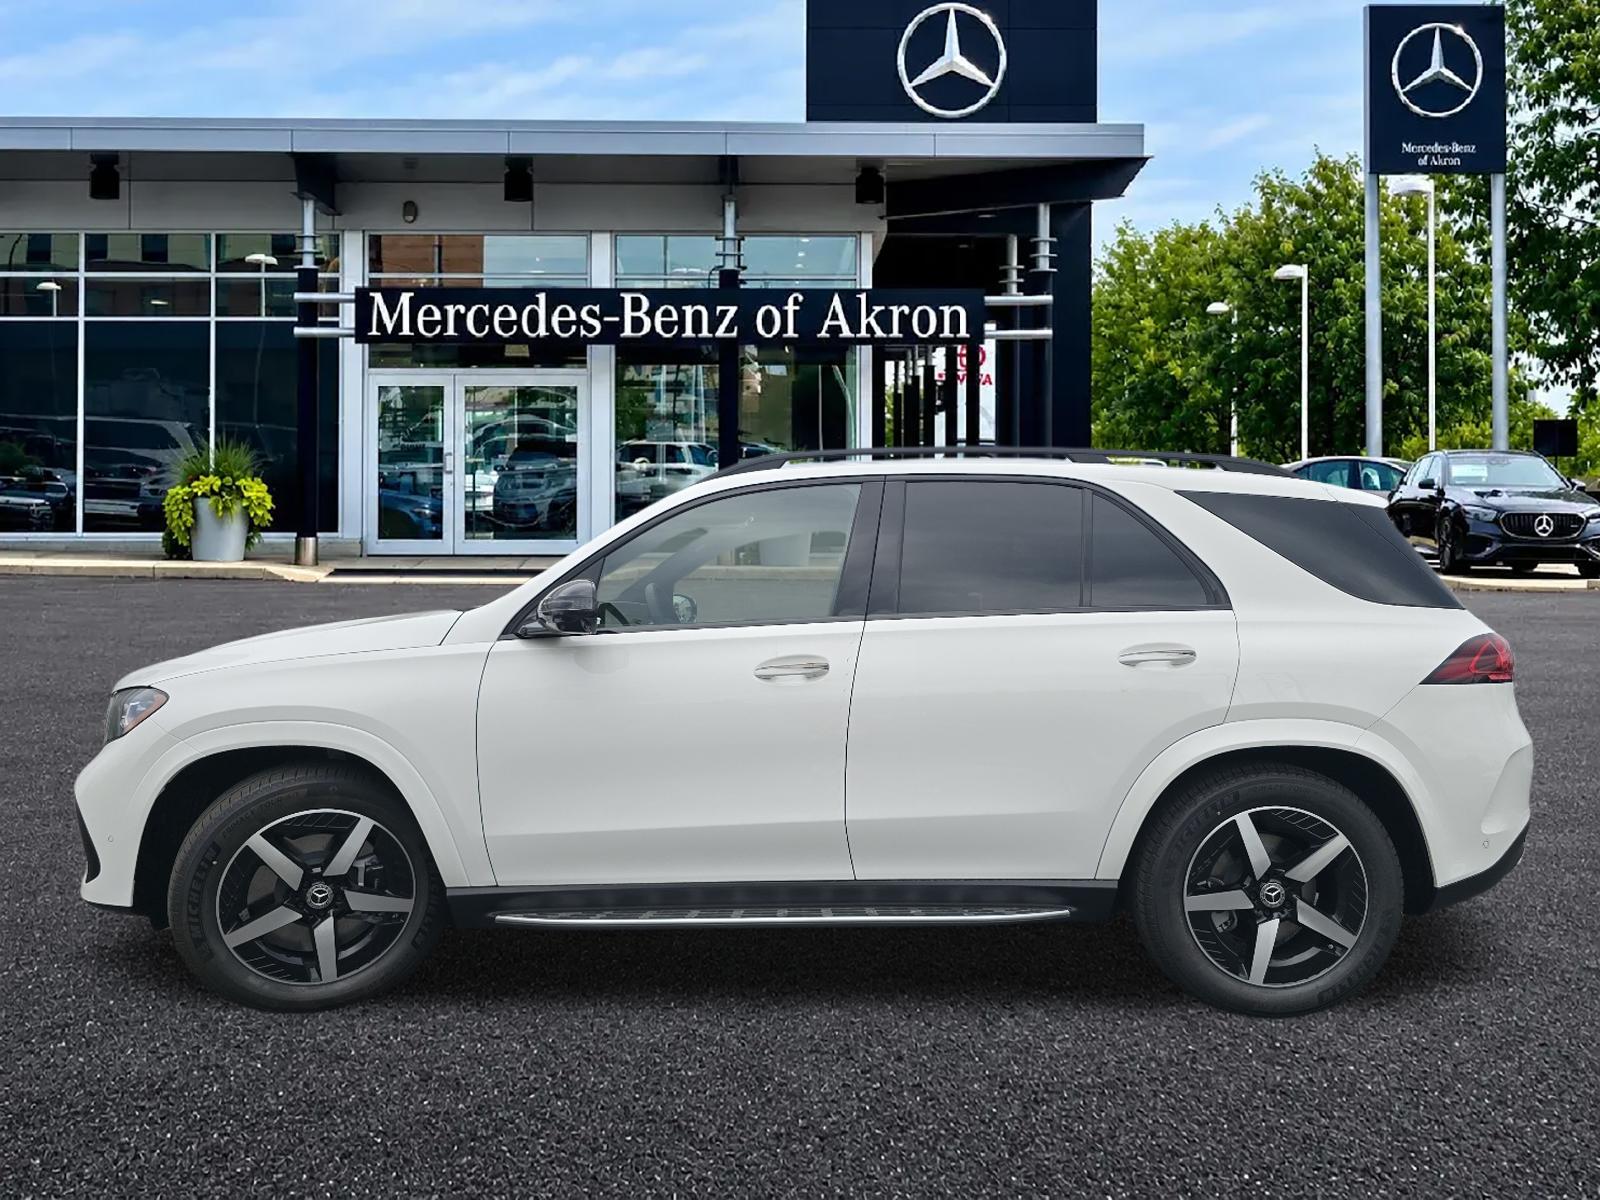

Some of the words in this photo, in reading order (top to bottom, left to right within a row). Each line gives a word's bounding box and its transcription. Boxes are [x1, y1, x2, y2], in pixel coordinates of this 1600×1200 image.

[1401, 142, 1476, 153] Mercedes-Benz
[1418, 155, 1428, 166] of
[1430, 155, 1461, 166] Akron
[367, 291, 739, 338] Mercedes-Benz
[756, 292, 804, 338] of
[817, 292, 971, 338] Akron
